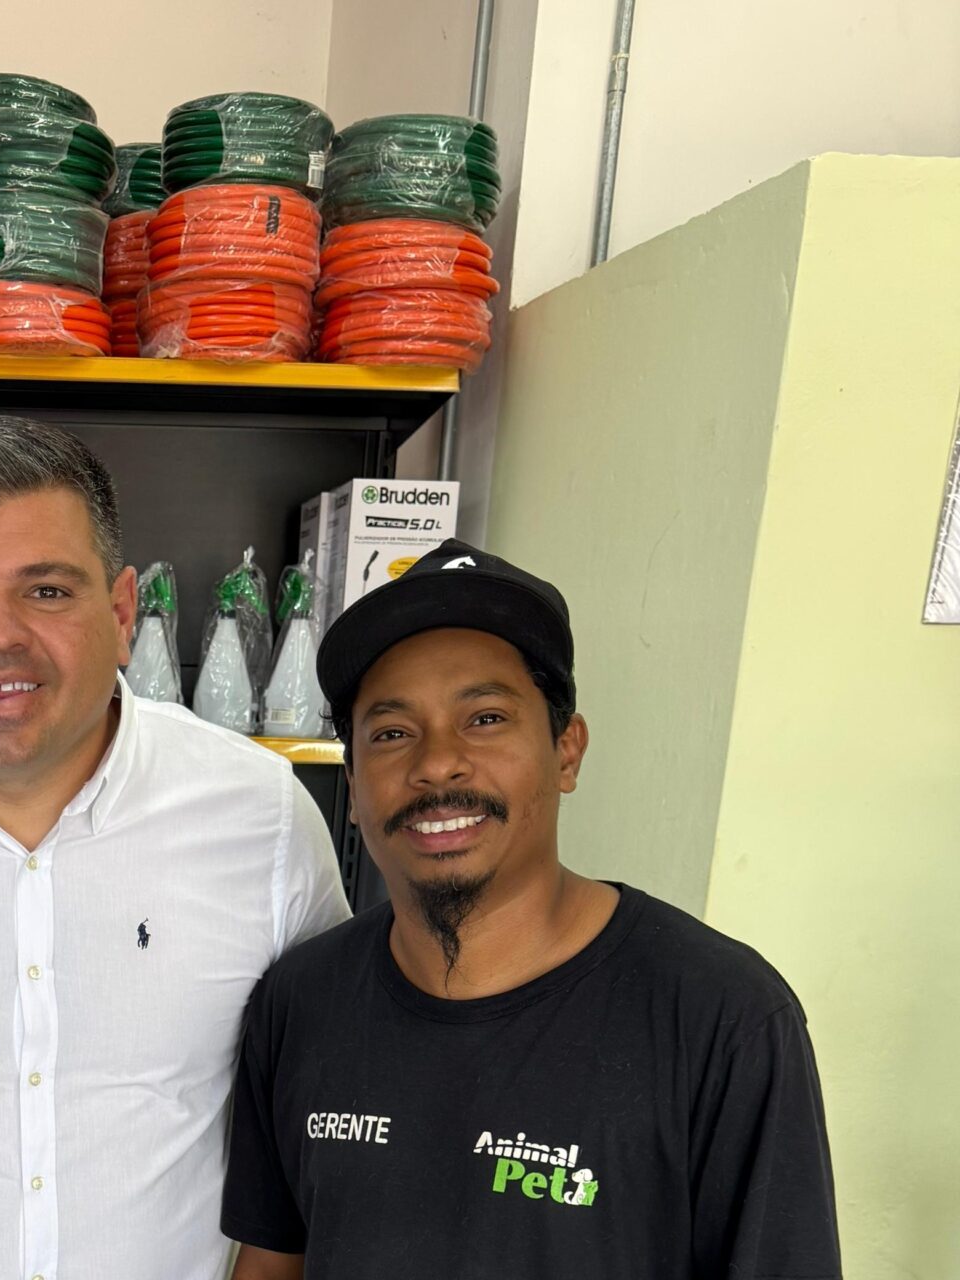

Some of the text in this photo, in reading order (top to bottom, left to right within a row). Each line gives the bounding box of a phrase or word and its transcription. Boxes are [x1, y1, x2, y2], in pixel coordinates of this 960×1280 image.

[379, 487, 450, 505] Brudden
[306, 1112, 392, 1144] GERENTE
[473, 1131, 580, 1168] Animal
[492, 1157, 569, 1205] Pet
